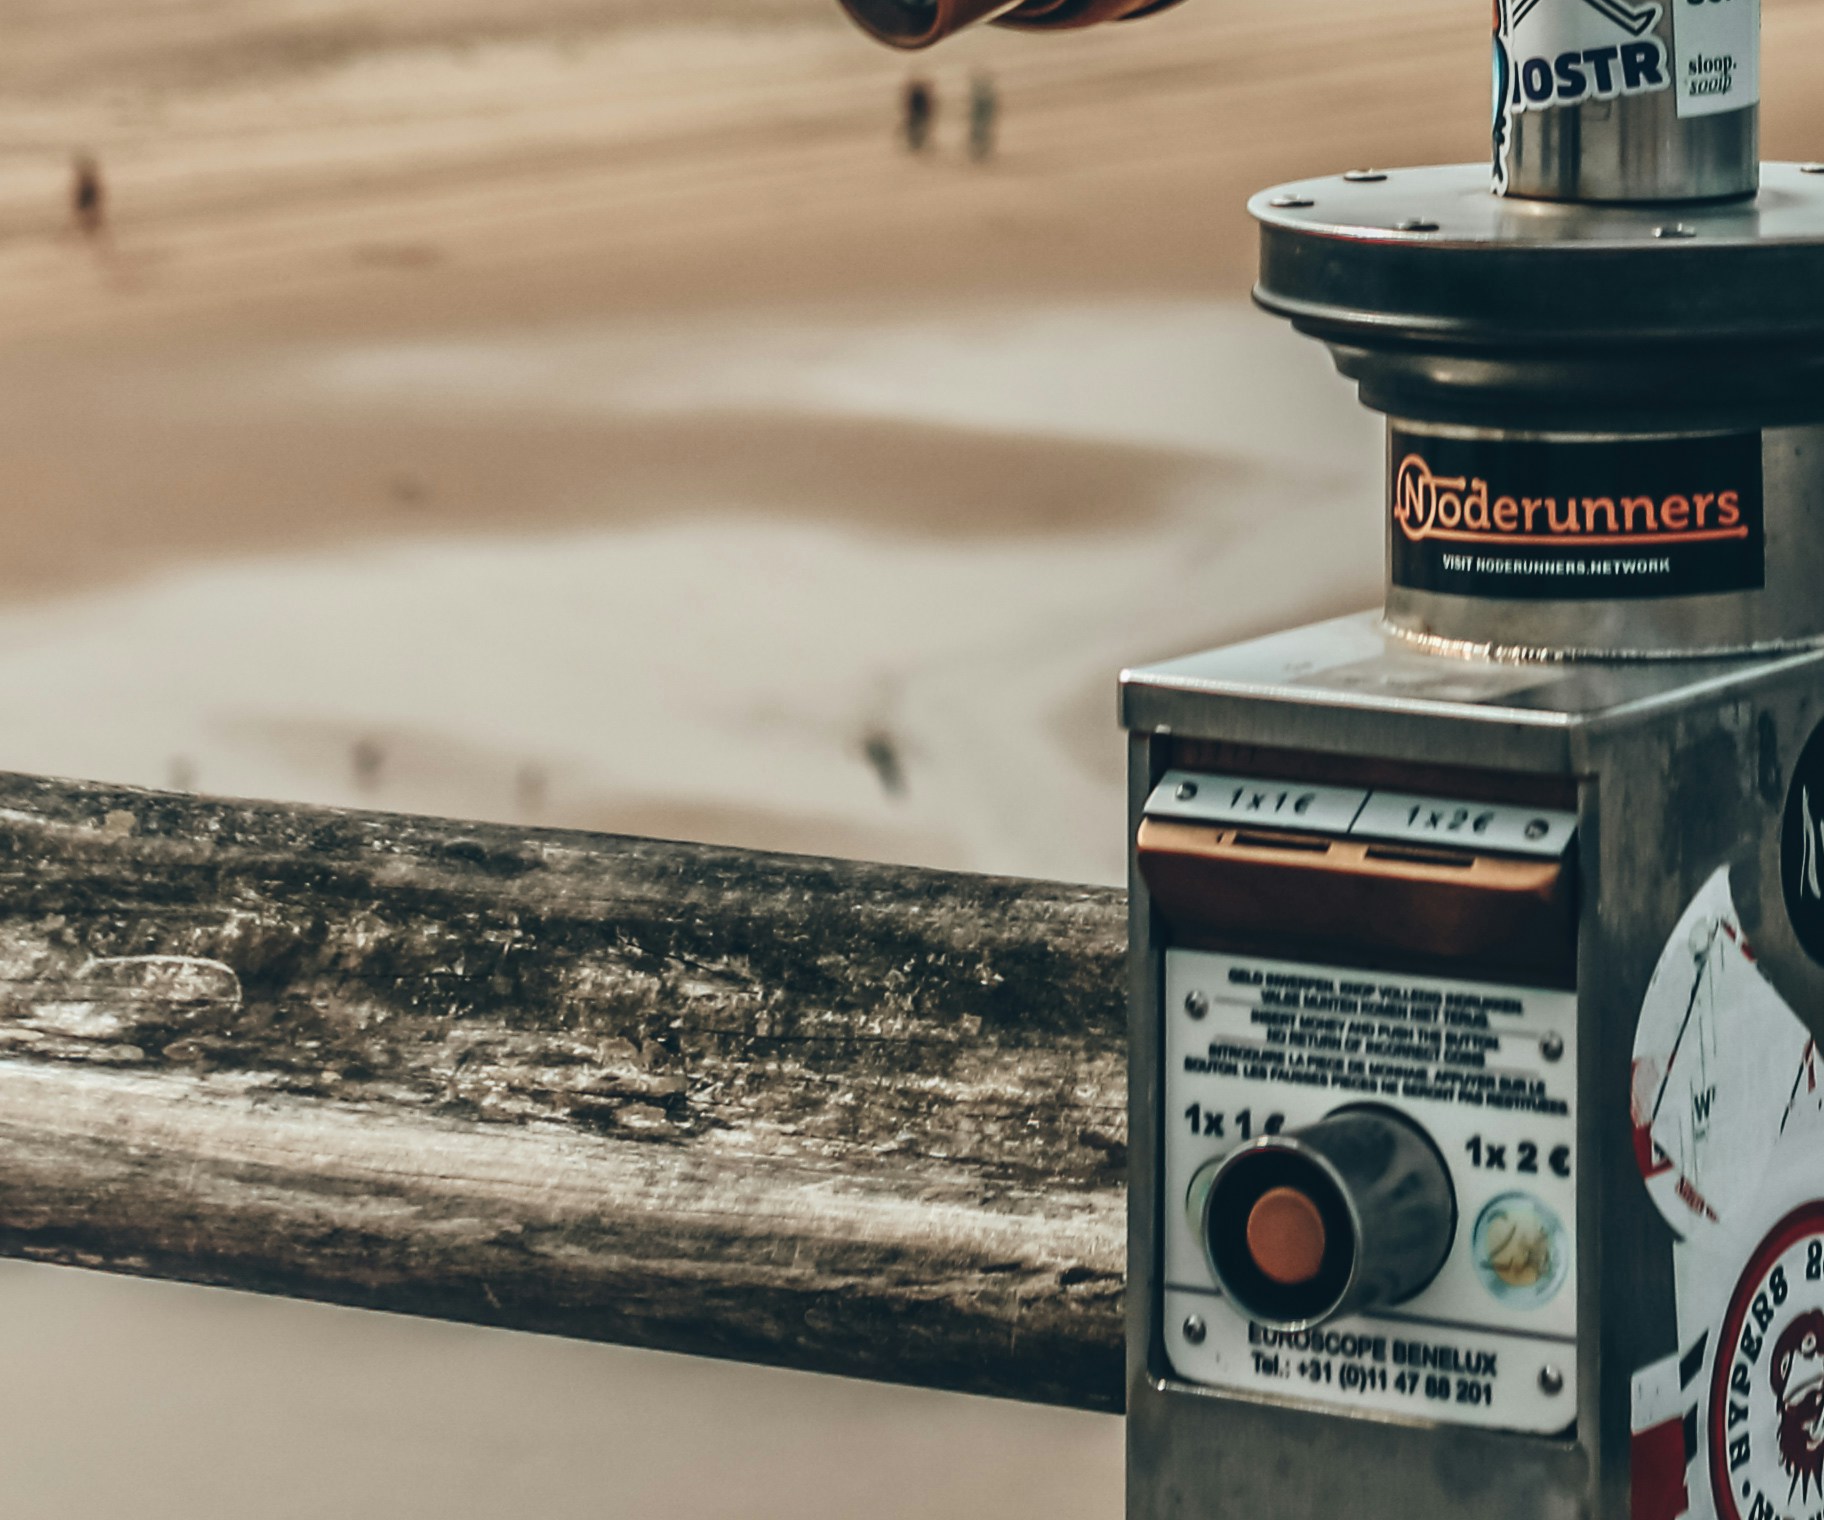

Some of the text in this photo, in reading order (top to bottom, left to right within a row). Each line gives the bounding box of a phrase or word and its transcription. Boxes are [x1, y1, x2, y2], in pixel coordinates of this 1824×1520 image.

[1398, 460, 1740, 536] Noderunners
[1442, 554, 1671, 576] VISIT NODERUNNERS.NETWORK
[1184, 1103, 1224, 1139] 1x
[1465, 1133, 1506, 1171] 1x
[1516, 1142, 1539, 1174] 2
[1391, 1337, 1498, 1377] BENELUX
[1297, 1357, 1332, 1384] +31
[1339, 1364, 1388, 1393] (0)11
[1456, 1382, 1494, 1407] 201
